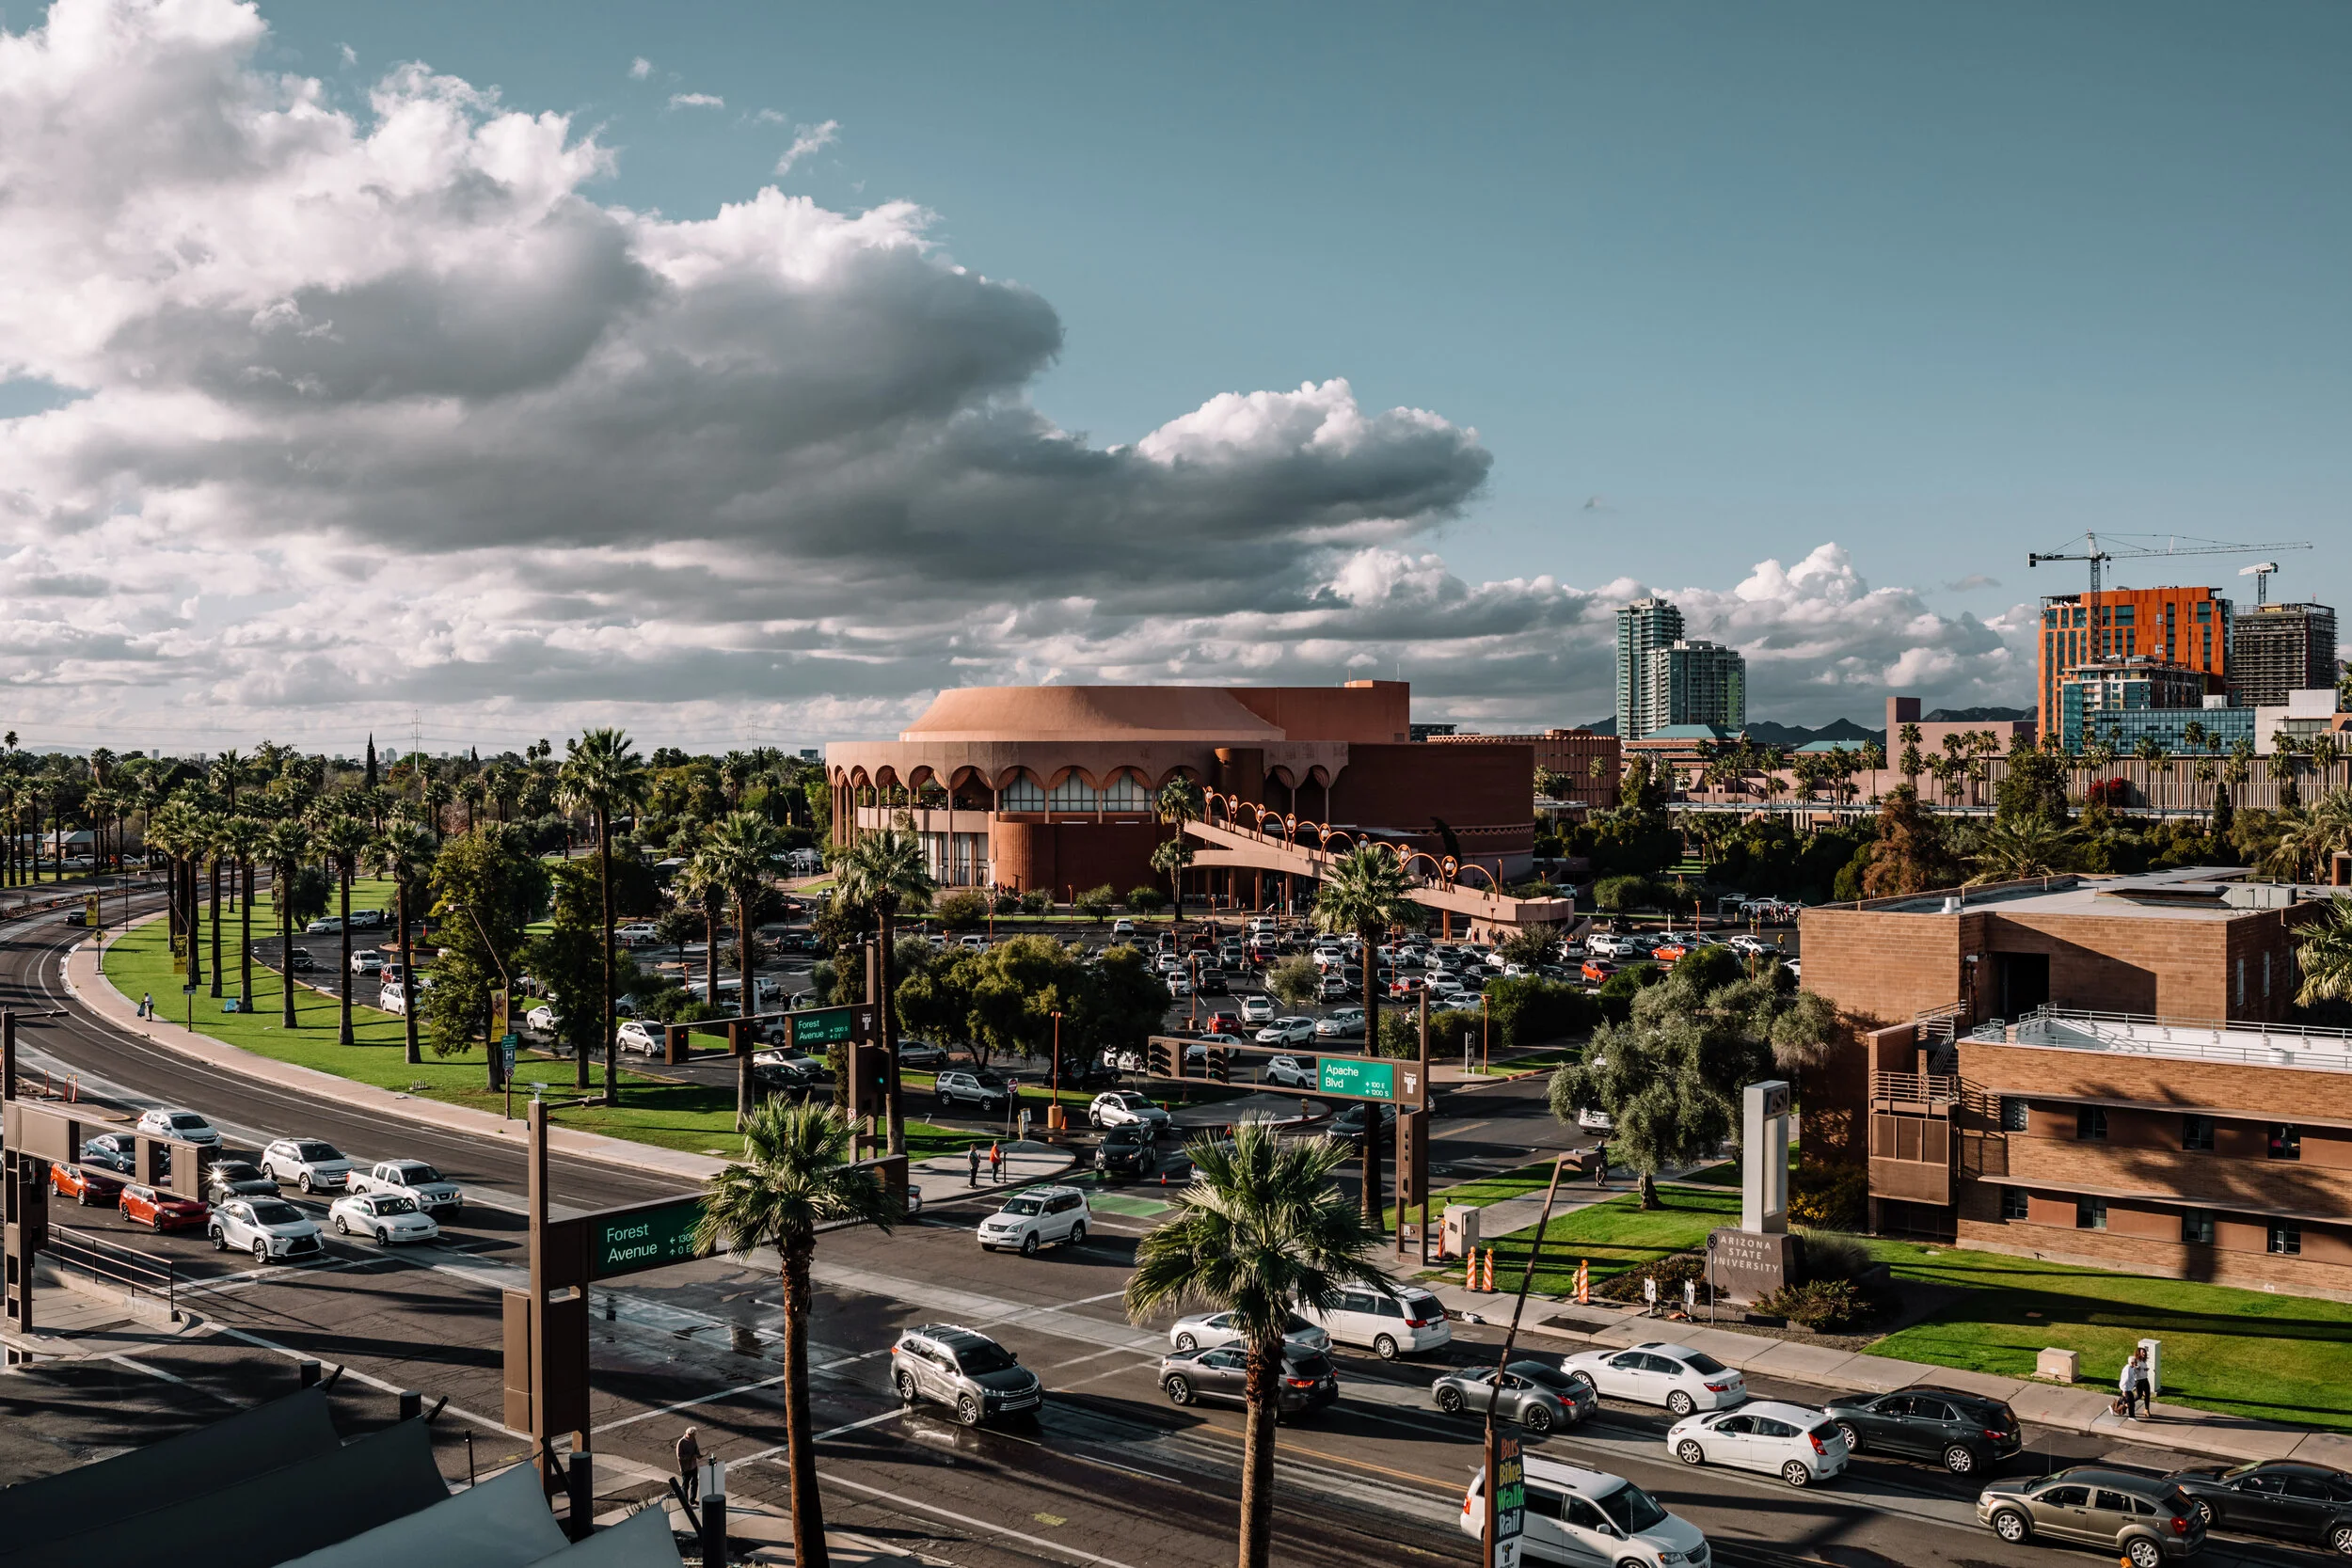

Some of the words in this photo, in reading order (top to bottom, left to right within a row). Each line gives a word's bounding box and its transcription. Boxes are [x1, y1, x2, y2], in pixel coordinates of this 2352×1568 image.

[798, 1020, 819, 1029] Forest
[799, 1031, 824, 1040] Avenue
[505, 1050, 513, 1060] H
[1326, 1064, 1359, 1077] Apache
[1325, 1077, 1343, 1088] Blvd
[607, 1224, 649, 1243] Forest
[1721, 1236, 1772, 1250] ARIZONA
[607, 1243, 658, 1263] Avenue
[677, 1245, 684, 1255] 0
[1728, 1248, 1762, 1260] STATE
[1499, 1461, 1521, 1486] Bike
[1497, 1484, 1525, 1513] Walk
[1499, 1509, 1520, 1537] Rail
